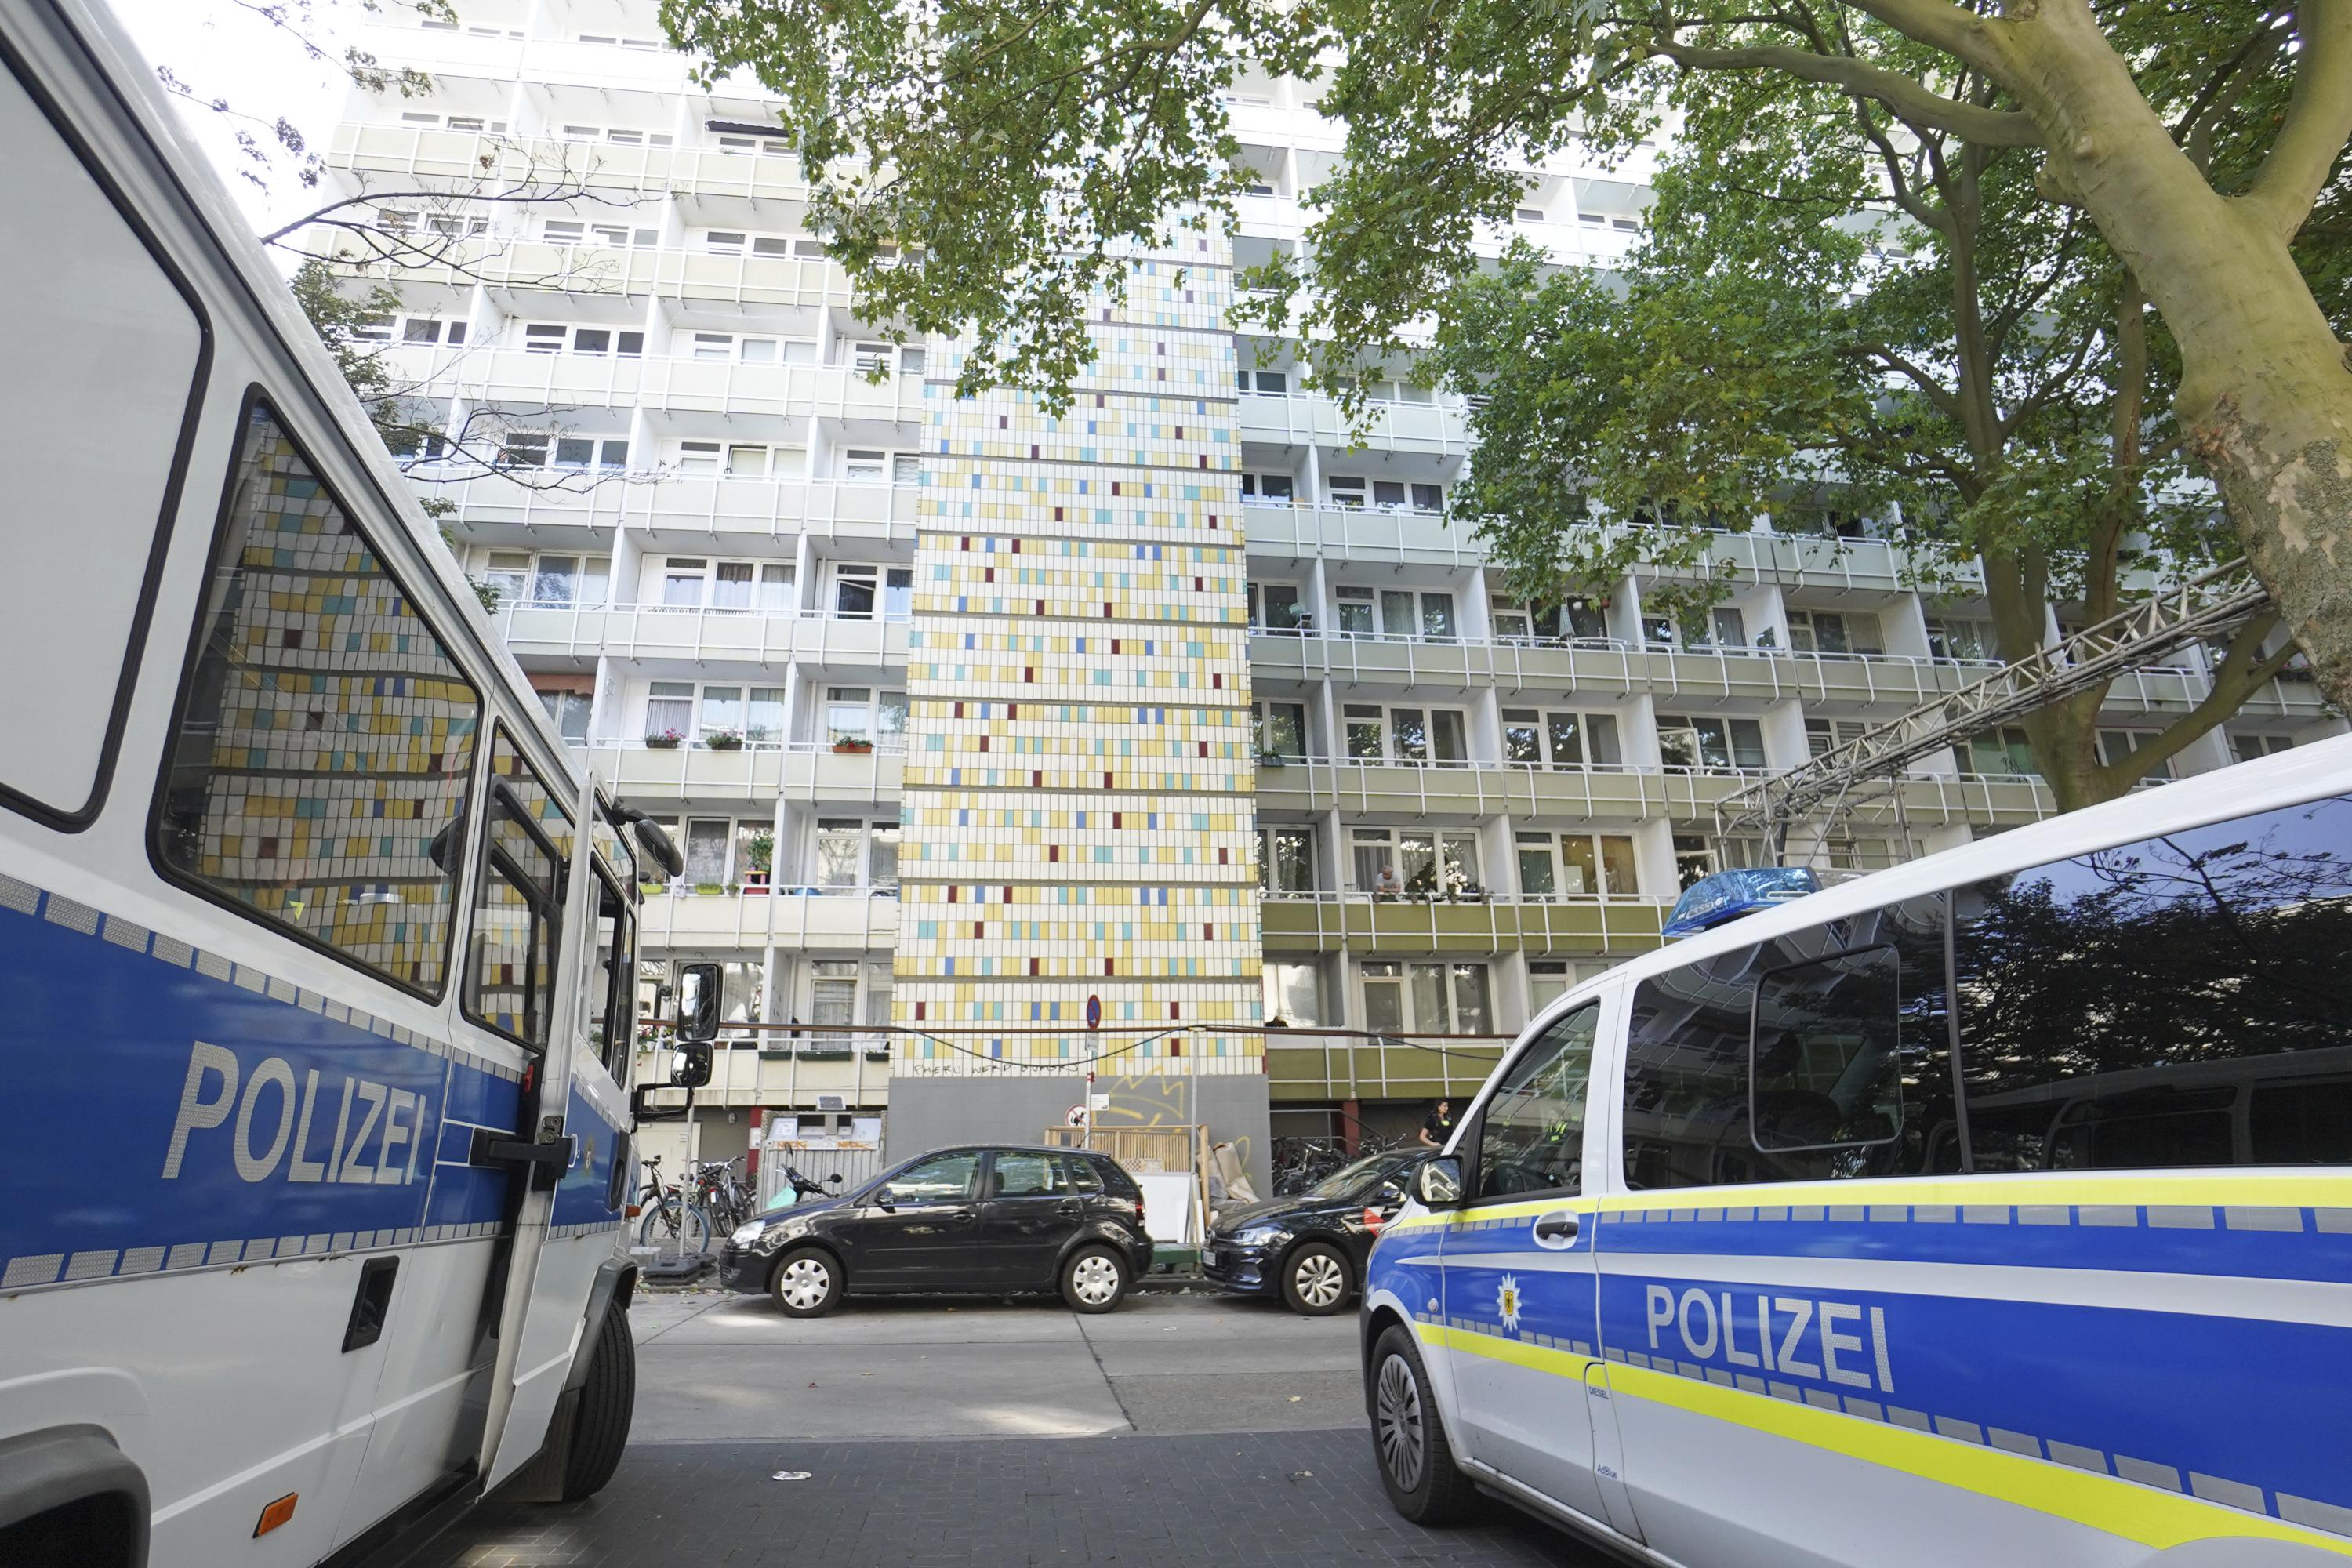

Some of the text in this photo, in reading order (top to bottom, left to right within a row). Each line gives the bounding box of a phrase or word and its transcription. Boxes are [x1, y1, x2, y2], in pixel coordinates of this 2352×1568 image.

[161, 1040, 426, 1185] POLIZEI
[1646, 1283, 1895, 1393] POLIZEI
[1588, 1385, 1610, 1399] DIESEL
[1597, 1463, 1617, 1479] AdBlue
